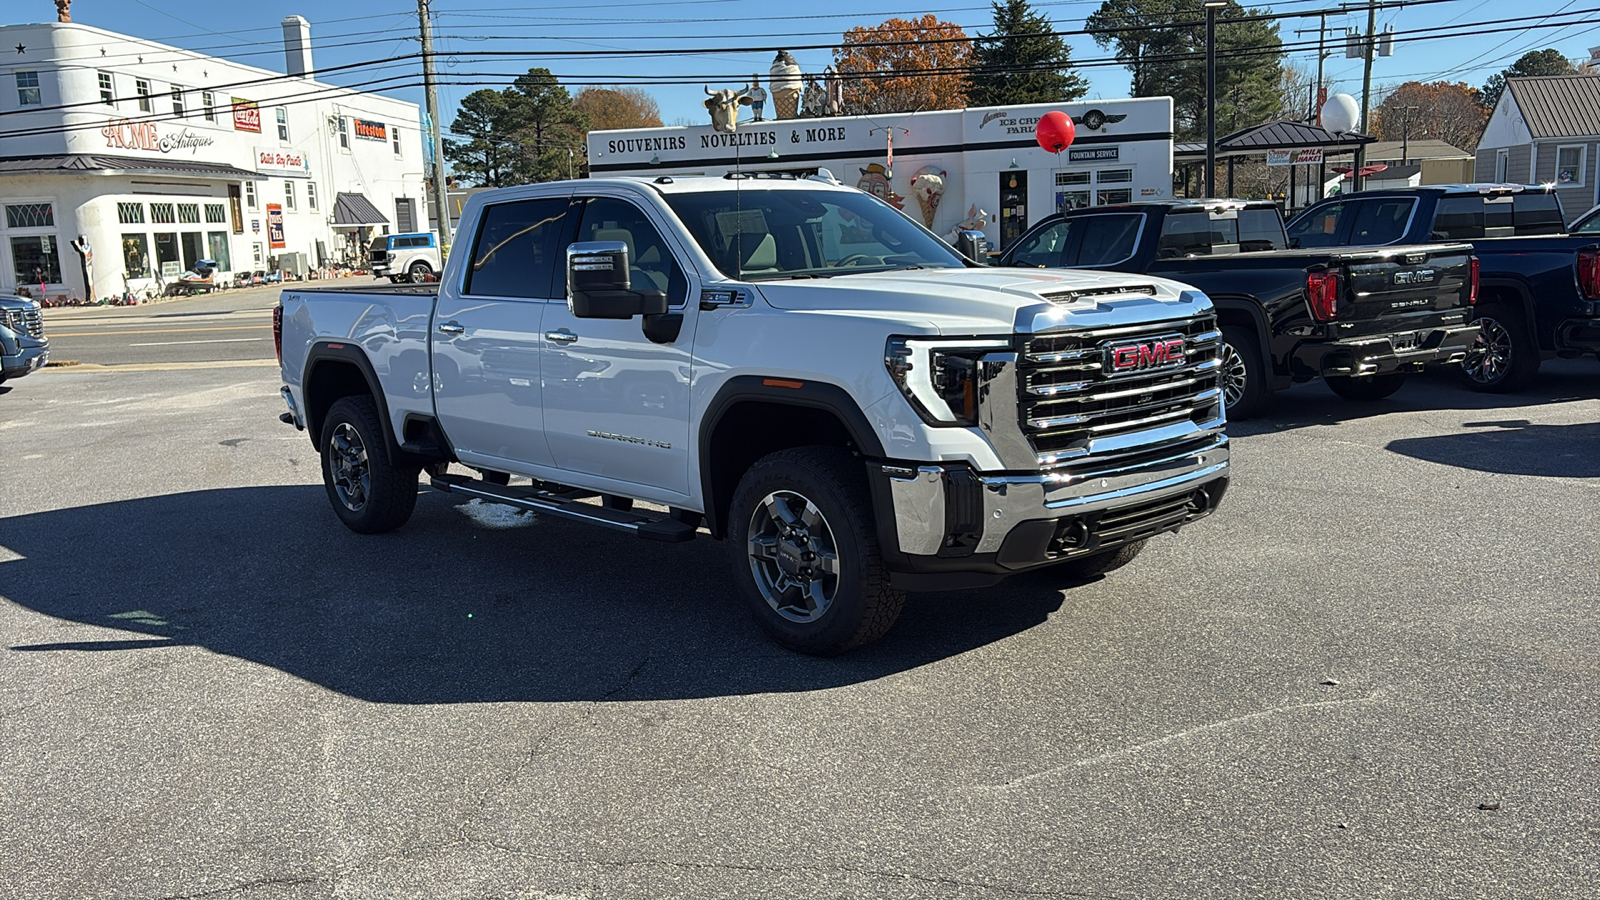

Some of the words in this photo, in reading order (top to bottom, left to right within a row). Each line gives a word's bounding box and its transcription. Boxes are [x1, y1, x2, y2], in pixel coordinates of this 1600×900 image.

[353, 119, 386, 139] Firestone
[999, 118, 1017, 127] ICE
[1018, 117, 1041, 126] CRE
[101, 117, 160, 152] ACME
[160, 127, 215, 155] Antiques
[1006, 126, 1037, 135] PARL
[608, 136, 686, 153] SOUVENIRS
[700, 131, 776, 148] NOVELTIES
[790, 130, 800, 143] &
[806, 127, 846, 143] MORE
[260, 152, 274, 164] Dutch
[276, 153, 286, 168] Boy
[286, 154, 302, 166] Paints
[1070, 151, 1096, 160] FOUNTAIN
[1096, 149, 1117, 158] SERVICE
[271, 229, 284, 240] TEA
[1394, 269, 1435, 285] GMC
[1391, 299, 1429, 308] DENALI
[1113, 340, 1184, 368] GMC
[586, 429, 645, 445] SIERRA
[647, 440, 672, 449] HD
